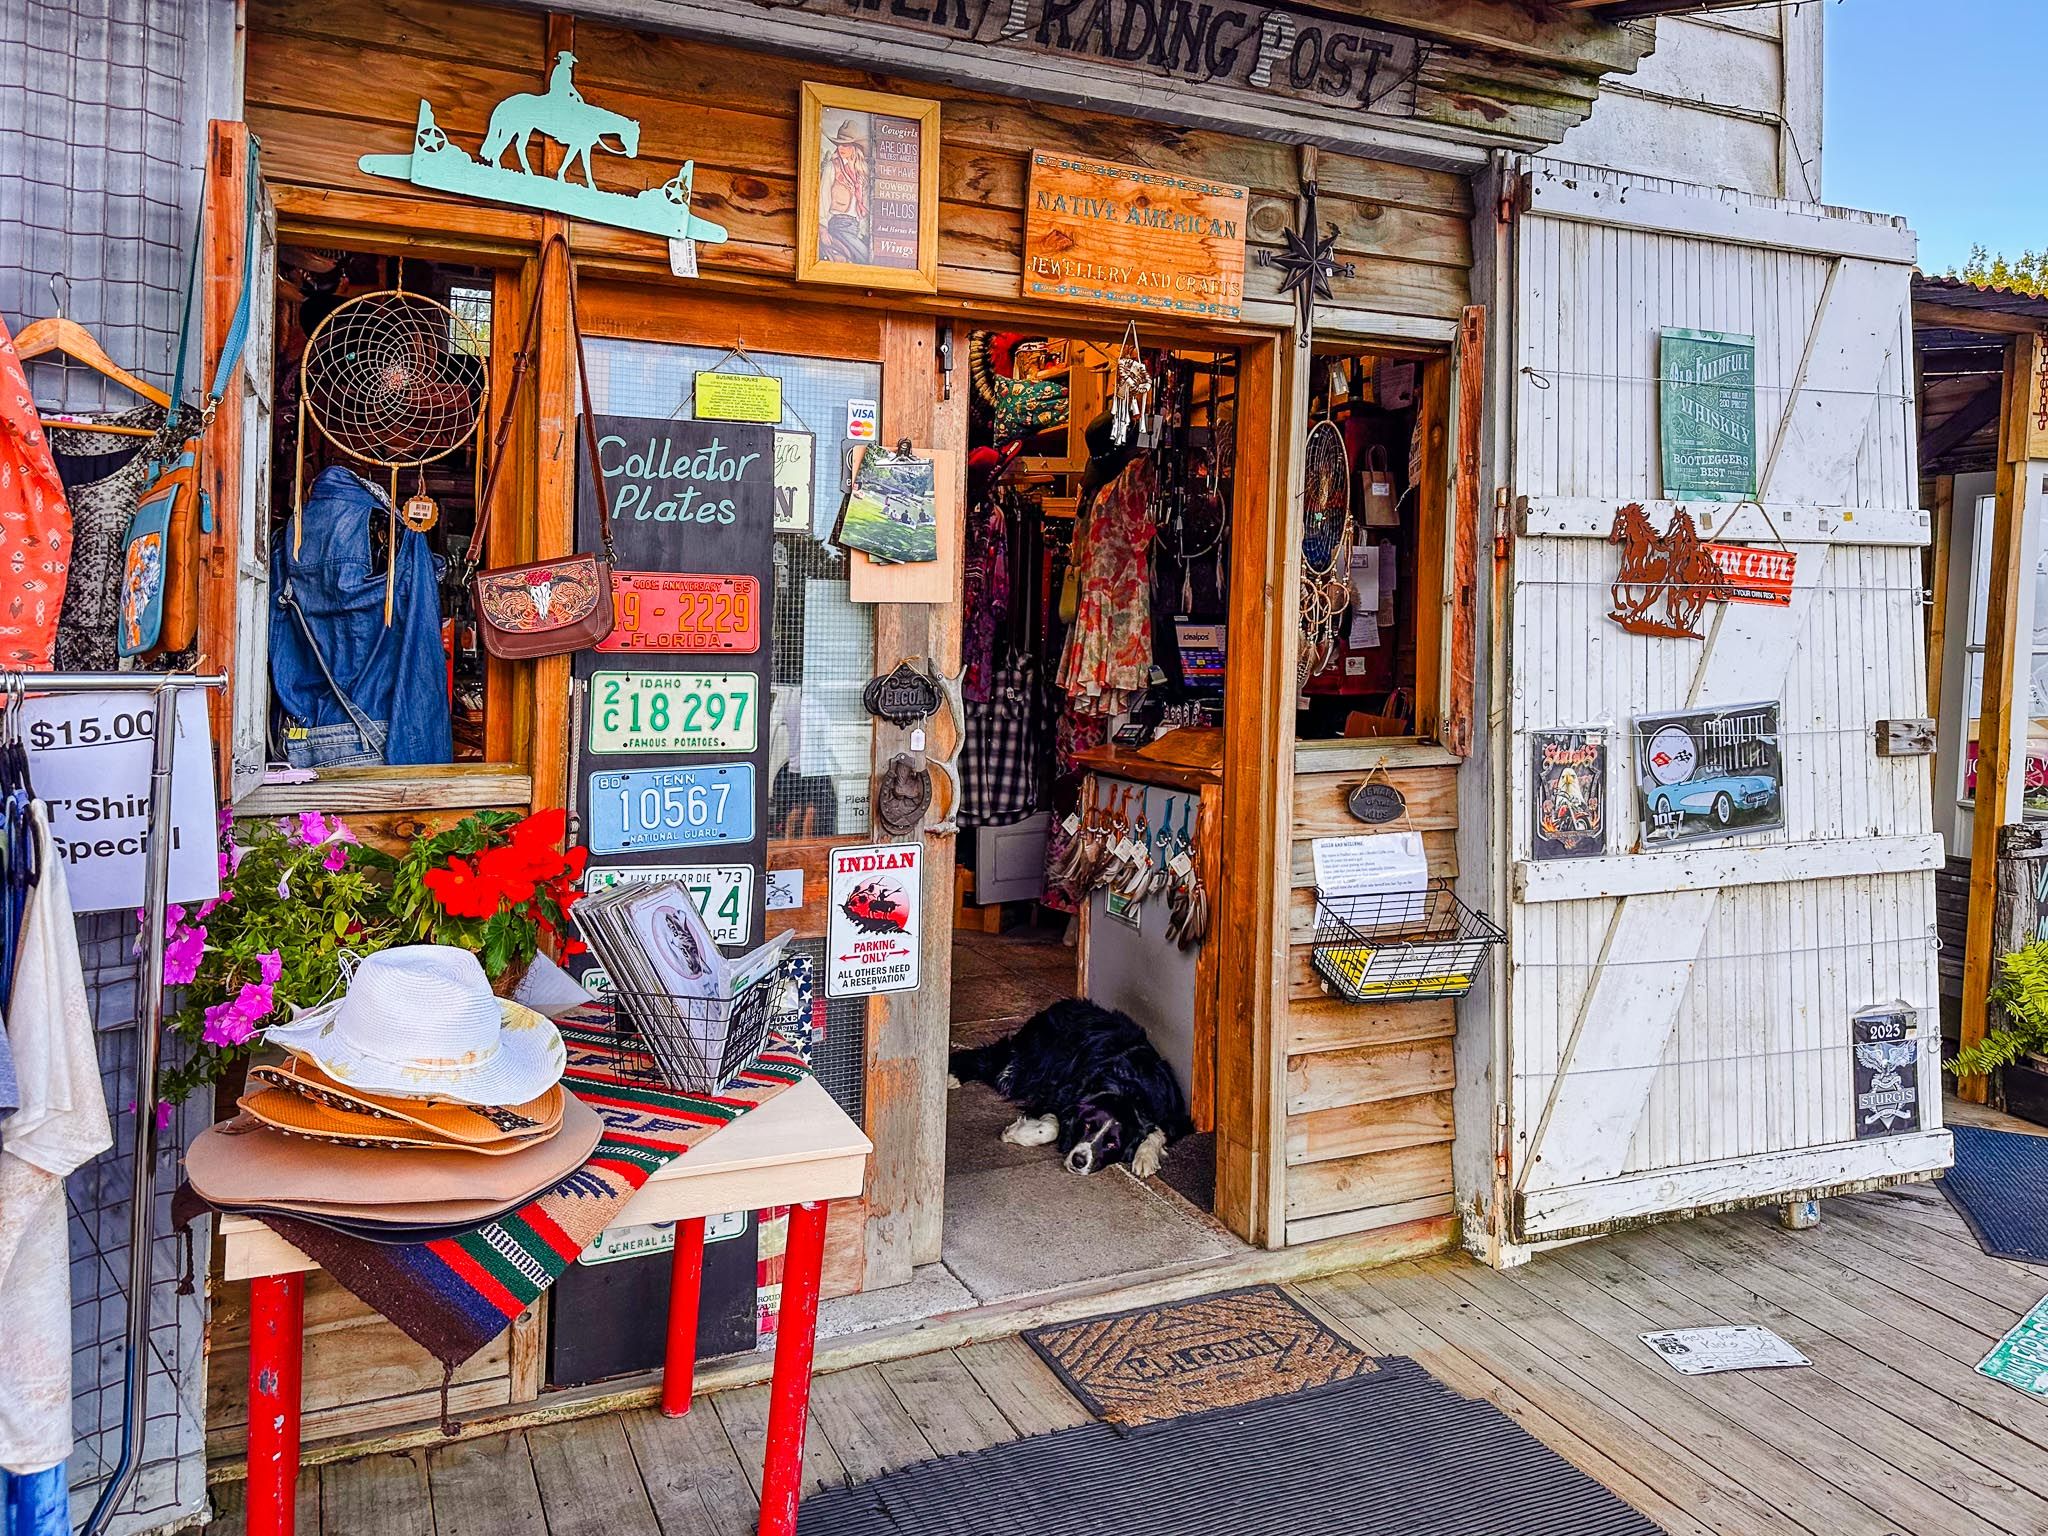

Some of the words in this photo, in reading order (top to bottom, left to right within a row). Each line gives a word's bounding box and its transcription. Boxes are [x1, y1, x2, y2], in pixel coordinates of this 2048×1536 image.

[1249, 11, 1394, 101] POST
[881, 124, 918, 138] Cowgirls
[880, 142, 895, 153] ARE
[896, 143, 918, 156] GOD'S
[879, 165, 897, 176] THEY
[897, 168, 916, 179] HAVE
[880, 180, 915, 192] COWBOY
[880, 190, 901, 200] HATS
[902, 192, 917, 201] FOR
[881, 201, 915, 219] HALOS
[1037, 190, 1119, 223] NATIVE
[1125, 205, 1238, 240] AMERICAN
[881, 240, 914, 258] Wings
[1257, 249, 1273, 267] W
[1026, 255, 1133, 285] JEWELLERY
[1136, 270, 1172, 289] AND
[1175, 275, 1241, 298] CRAFTS
[1299, 331, 1309, 349] S
[1669, 361, 1694, 391] OLD
[1695, 353, 1750, 387] FAITHFULL
[1719, 399, 1730, 408] 200
[851, 408, 875, 419] VISA
[1680, 394, 1750, 446] WHISKEY
[597, 434, 761, 483] Collector
[1673, 453, 1749, 466] BOOTLEGGERS
[1700, 467, 1725, 477] BEST
[611, 484, 737, 526] Plates
[1745, 553, 1790, 581] CAVE
[662, 581, 723, 593] ANNIVERSARY
[733, 581, 752, 593] 65
[1736, 589, 1751, 597] YOUR
[1751, 590, 1763, 598] OWN
[678, 593, 750, 632] 2229
[631, 633, 722, 648] FLORIDA
[1183, 632, 1209, 642] idealpos
[640, 678, 682, 689] IDAHO
[695, 679, 712, 689] 74
[604, 680, 621, 705] 2
[603, 708, 620, 732] C
[629, 692, 671, 732] 18
[682, 692, 749, 732] 297
[30, 710, 154, 751] $15.00
[629, 738, 667, 748] FAMOUS
[674, 737, 720, 748] POTATOES
[599, 777, 621, 789] 80
[652, 773, 696, 787] TENN
[620, 783, 731, 833] 10567
[853, 807, 864, 816] To
[1364, 808, 1389, 819] KIDS
[1652, 811, 1685, 830] 1957
[630, 831, 679, 844] NATIONAL
[684, 828, 718, 839] GUARD
[54, 826, 180, 865] Specil
[838, 852, 916, 874] INDIAN
[682, 873, 694, 883] OR
[694, 873, 711, 883] DIE
[724, 871, 742, 883] 73
[854, 940, 896, 954] PARKING
[862, 951, 888, 964] ONLY
[838, 969, 854, 980] ALL
[855, 966, 887, 978] OTHERS
[889, 963, 911, 974] NEED
[842, 978, 849, 988] A
[850, 973, 906, 988] RESERVATION
[1870, 1023, 1901, 1039] 2023
[1861, 1090, 1914, 1106] STURGIS
[608, 1234, 658, 1254] GENERAL
[1668, 1346, 1686, 1354] 66
